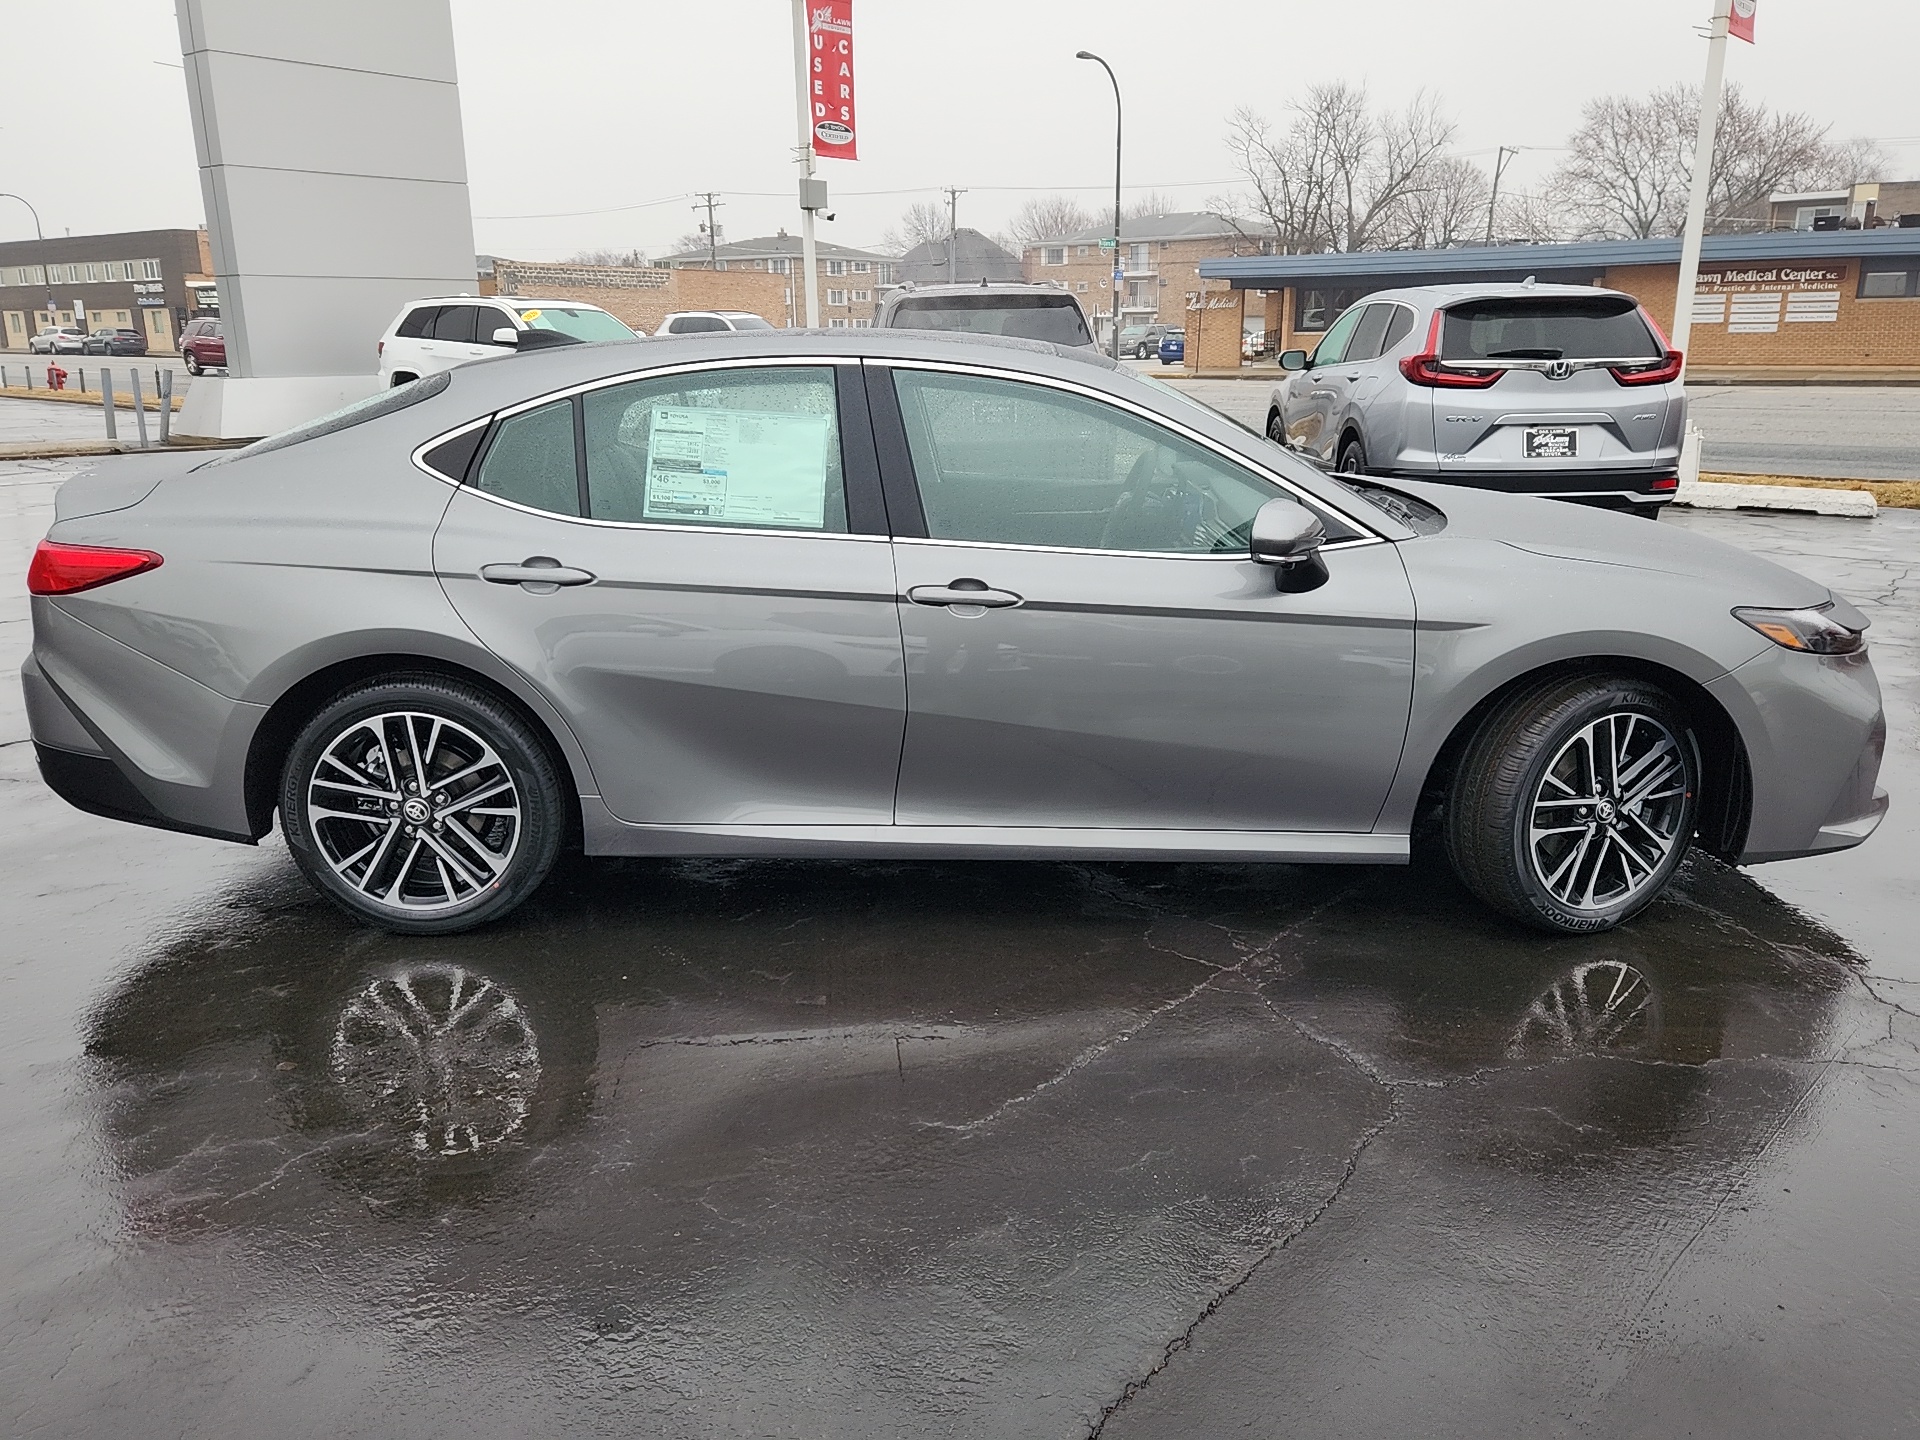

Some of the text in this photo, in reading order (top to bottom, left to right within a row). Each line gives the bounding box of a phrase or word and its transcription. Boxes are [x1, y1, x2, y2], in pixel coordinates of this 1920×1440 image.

[814, 34, 826, 117] USED
[838, 39, 851, 121] CARS
[1696, 273, 1722, 284] awn
[1723, 269, 1778, 282] Medical
[1780, 268, 1827, 282] Center
[1713, 284, 1747, 292] Practice
[1750, 283, 1757, 291] &
[1761, 283, 1795, 291] Internal
[1800, 282, 1839, 290] Medicine
[1206, 296, 1239, 310] Medical
[1445, 415, 1484, 424] CR-V
[656, 474, 670, 484] 46
[286, 774, 301, 837] KINERGY
